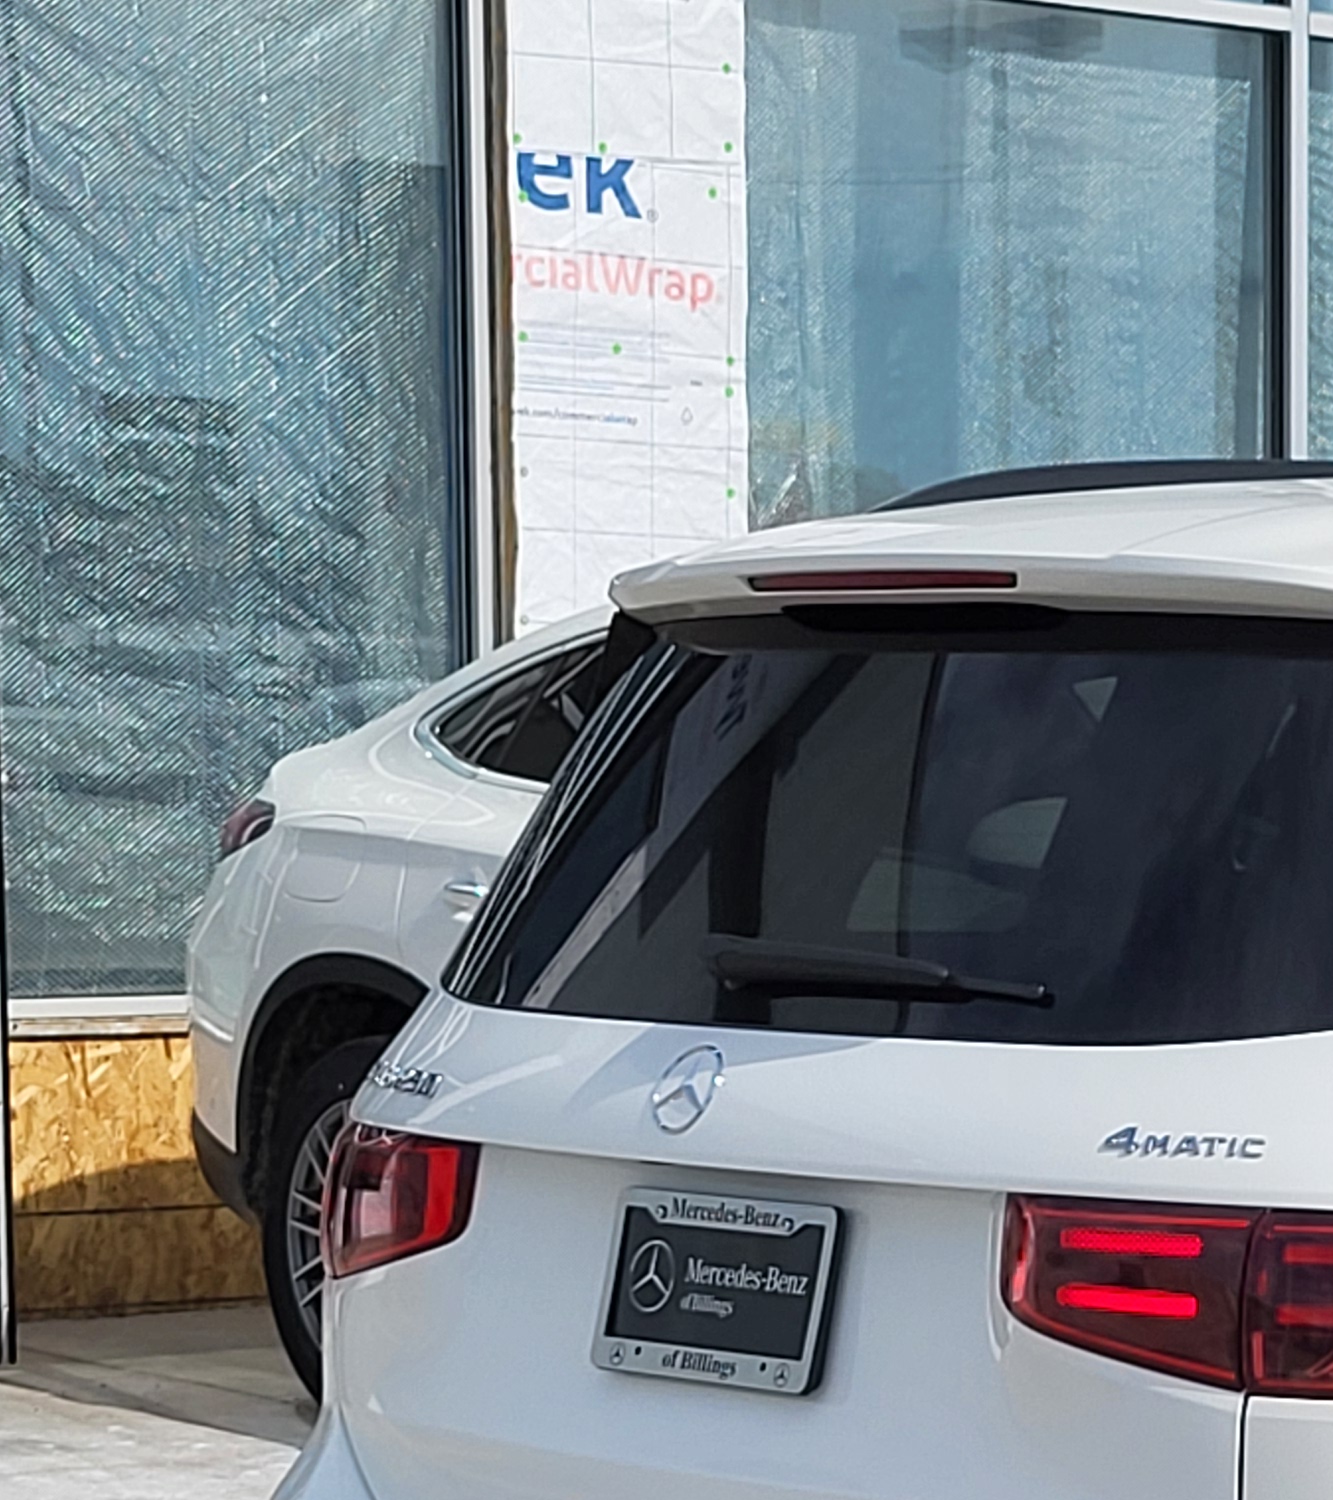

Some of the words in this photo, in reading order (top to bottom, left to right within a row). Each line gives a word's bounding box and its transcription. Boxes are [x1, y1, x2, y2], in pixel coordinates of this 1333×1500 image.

[1098, 1126, 1267, 1159] 4MATIC
[671, 1198, 781, 1228] Mercedes-Benz
[685, 1257, 808, 1295] Mercedes-Benz
[662, 1350, 679, 1369] of
[681, 1352, 737, 1380] Billings
